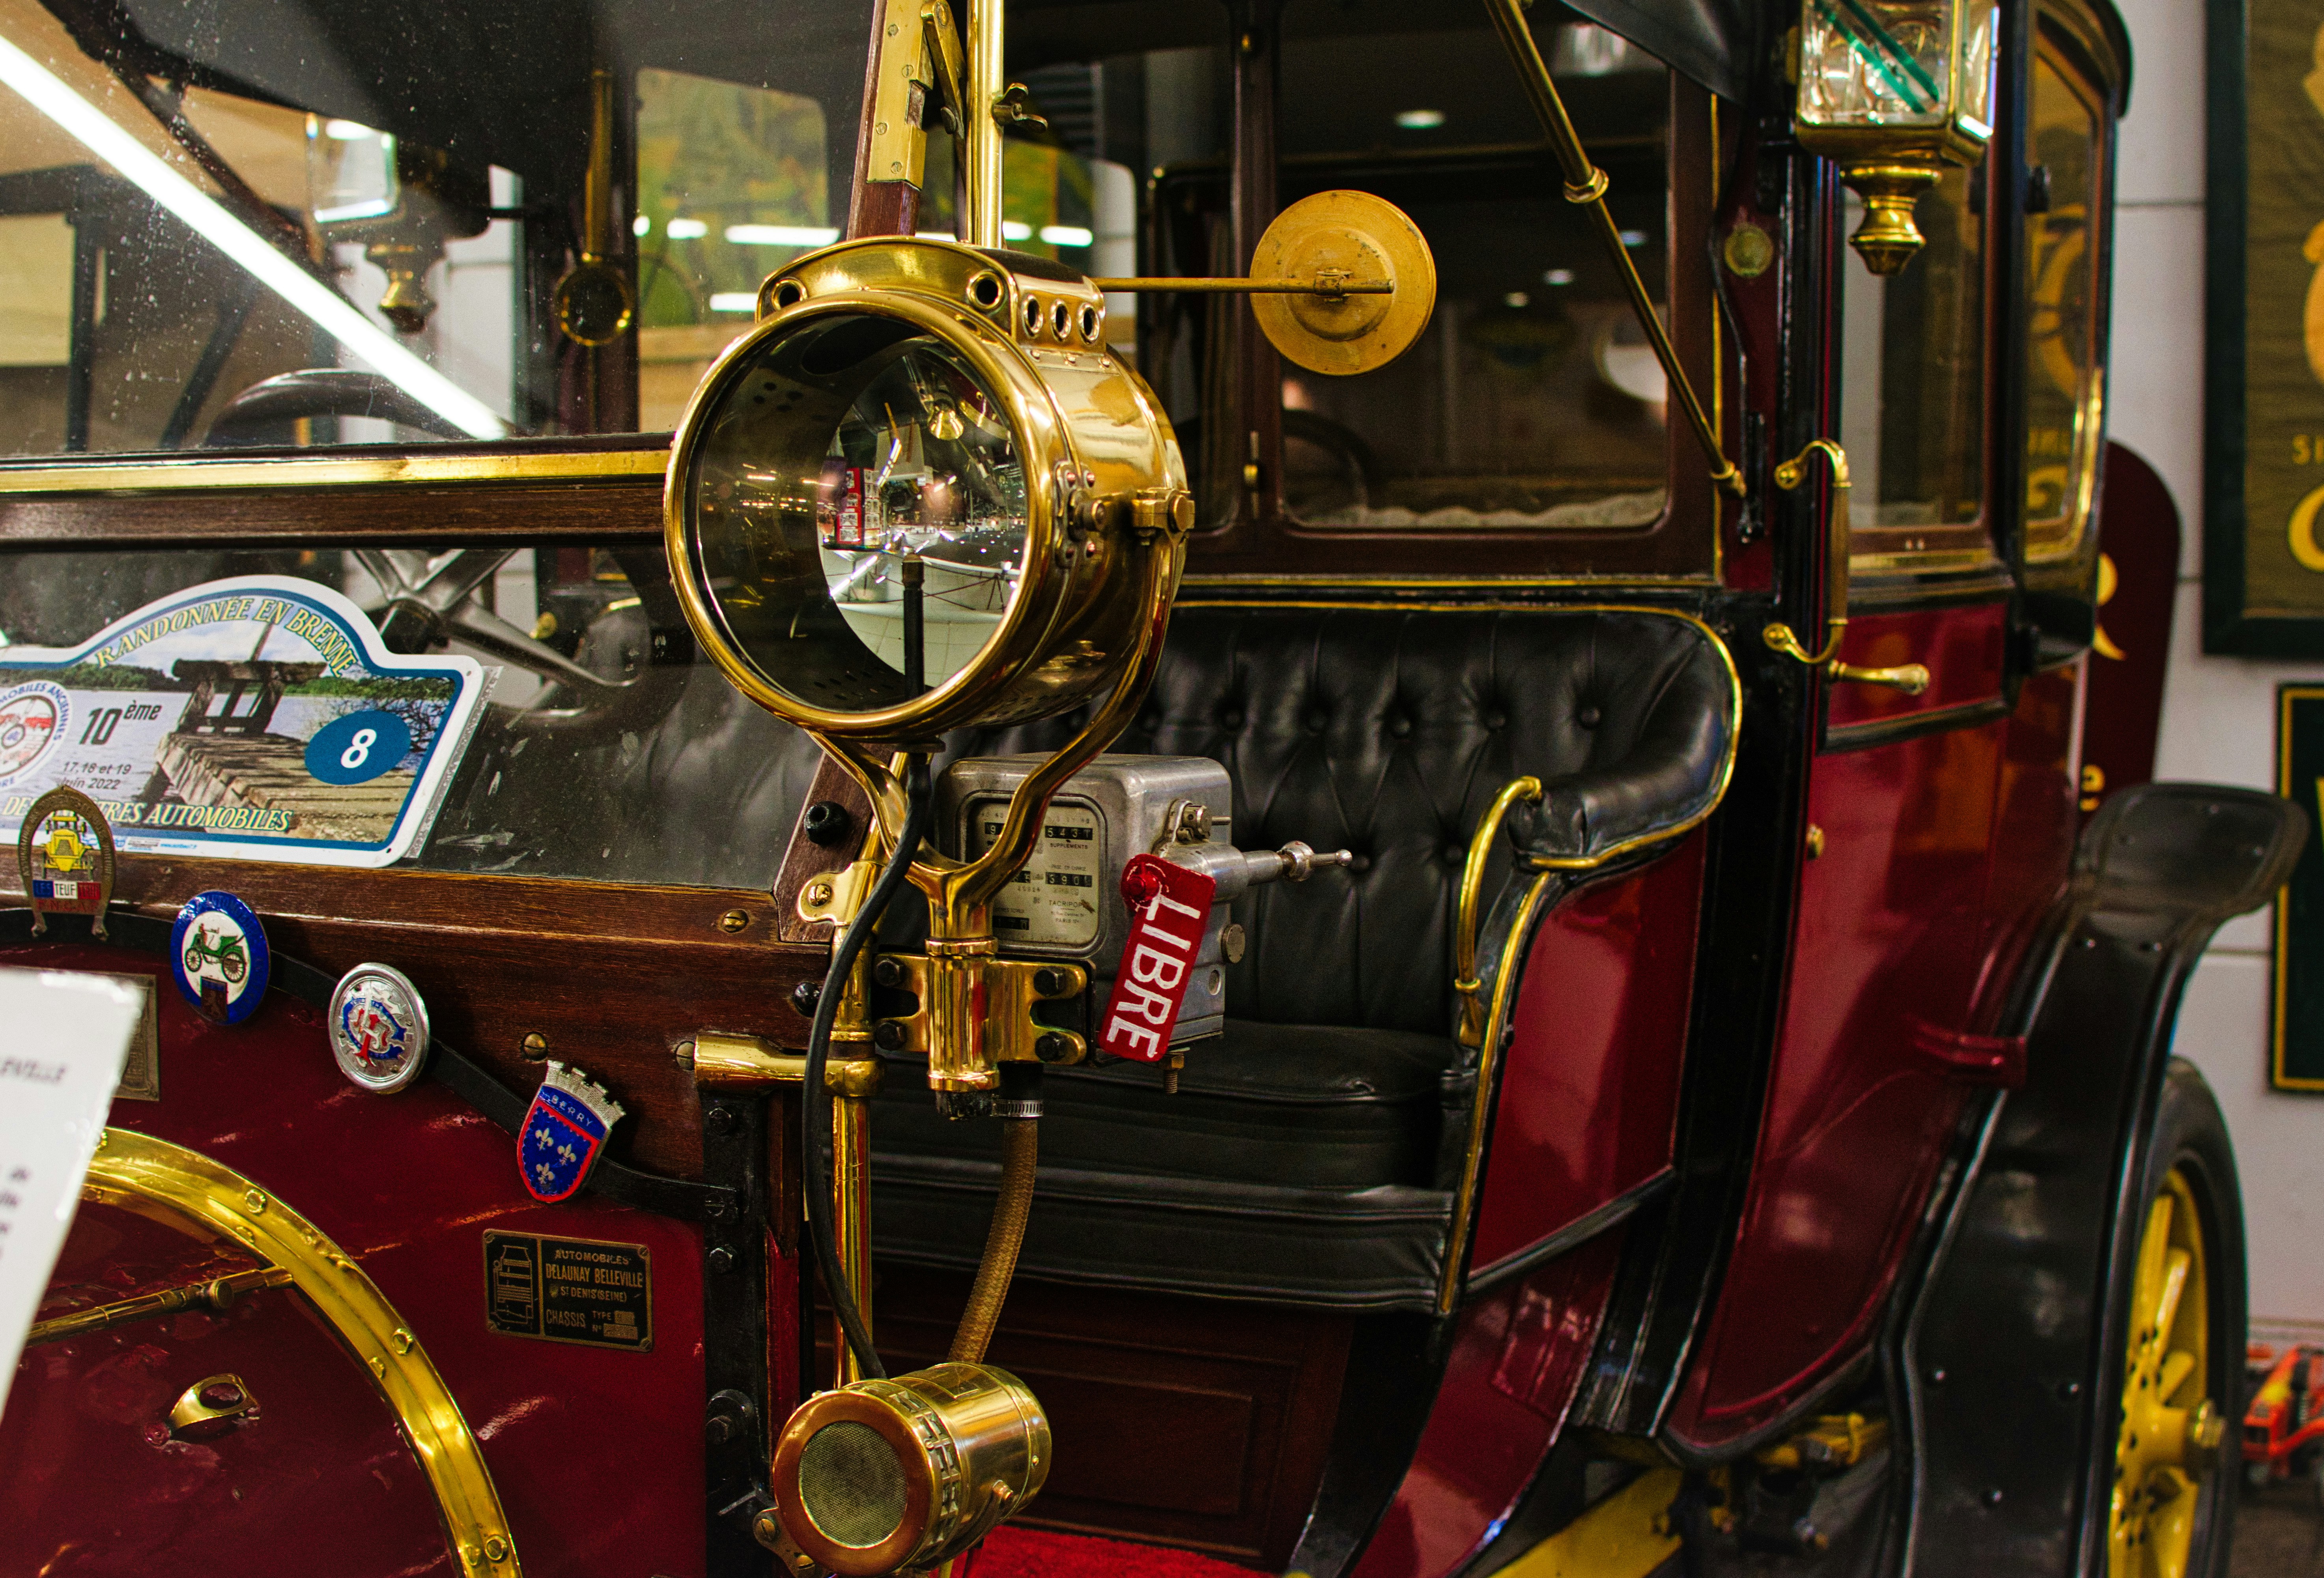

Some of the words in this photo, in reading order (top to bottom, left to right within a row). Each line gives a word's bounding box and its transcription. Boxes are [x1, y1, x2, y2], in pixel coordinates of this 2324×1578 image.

[95, 596, 254, 669] RANDONNÉE
[252, 599, 294, 625] EN
[284, 608, 358, 678] BRENNE
[340, 728, 377, 768] 8
[98, 764, 112, 774] et
[116, 764, 132, 774] 19
[88, 778, 121, 789] 2022
[143, 803, 293, 831] AUTOMOBILES
[55, 883, 75, 896] TEUF
[1106, 894, 1201, 1058] LIBRE
[551, 1094, 593, 1126] BERRY
[555, 1249, 629, 1266] AUTOMOBILES
[546, 1263, 590, 1282] DELAUNAY
[594, 1268, 644, 1288] BELLEVILLE
[546, 1309, 586, 1328] CHASSIS
[592, 1310, 612, 1321] TYPE
